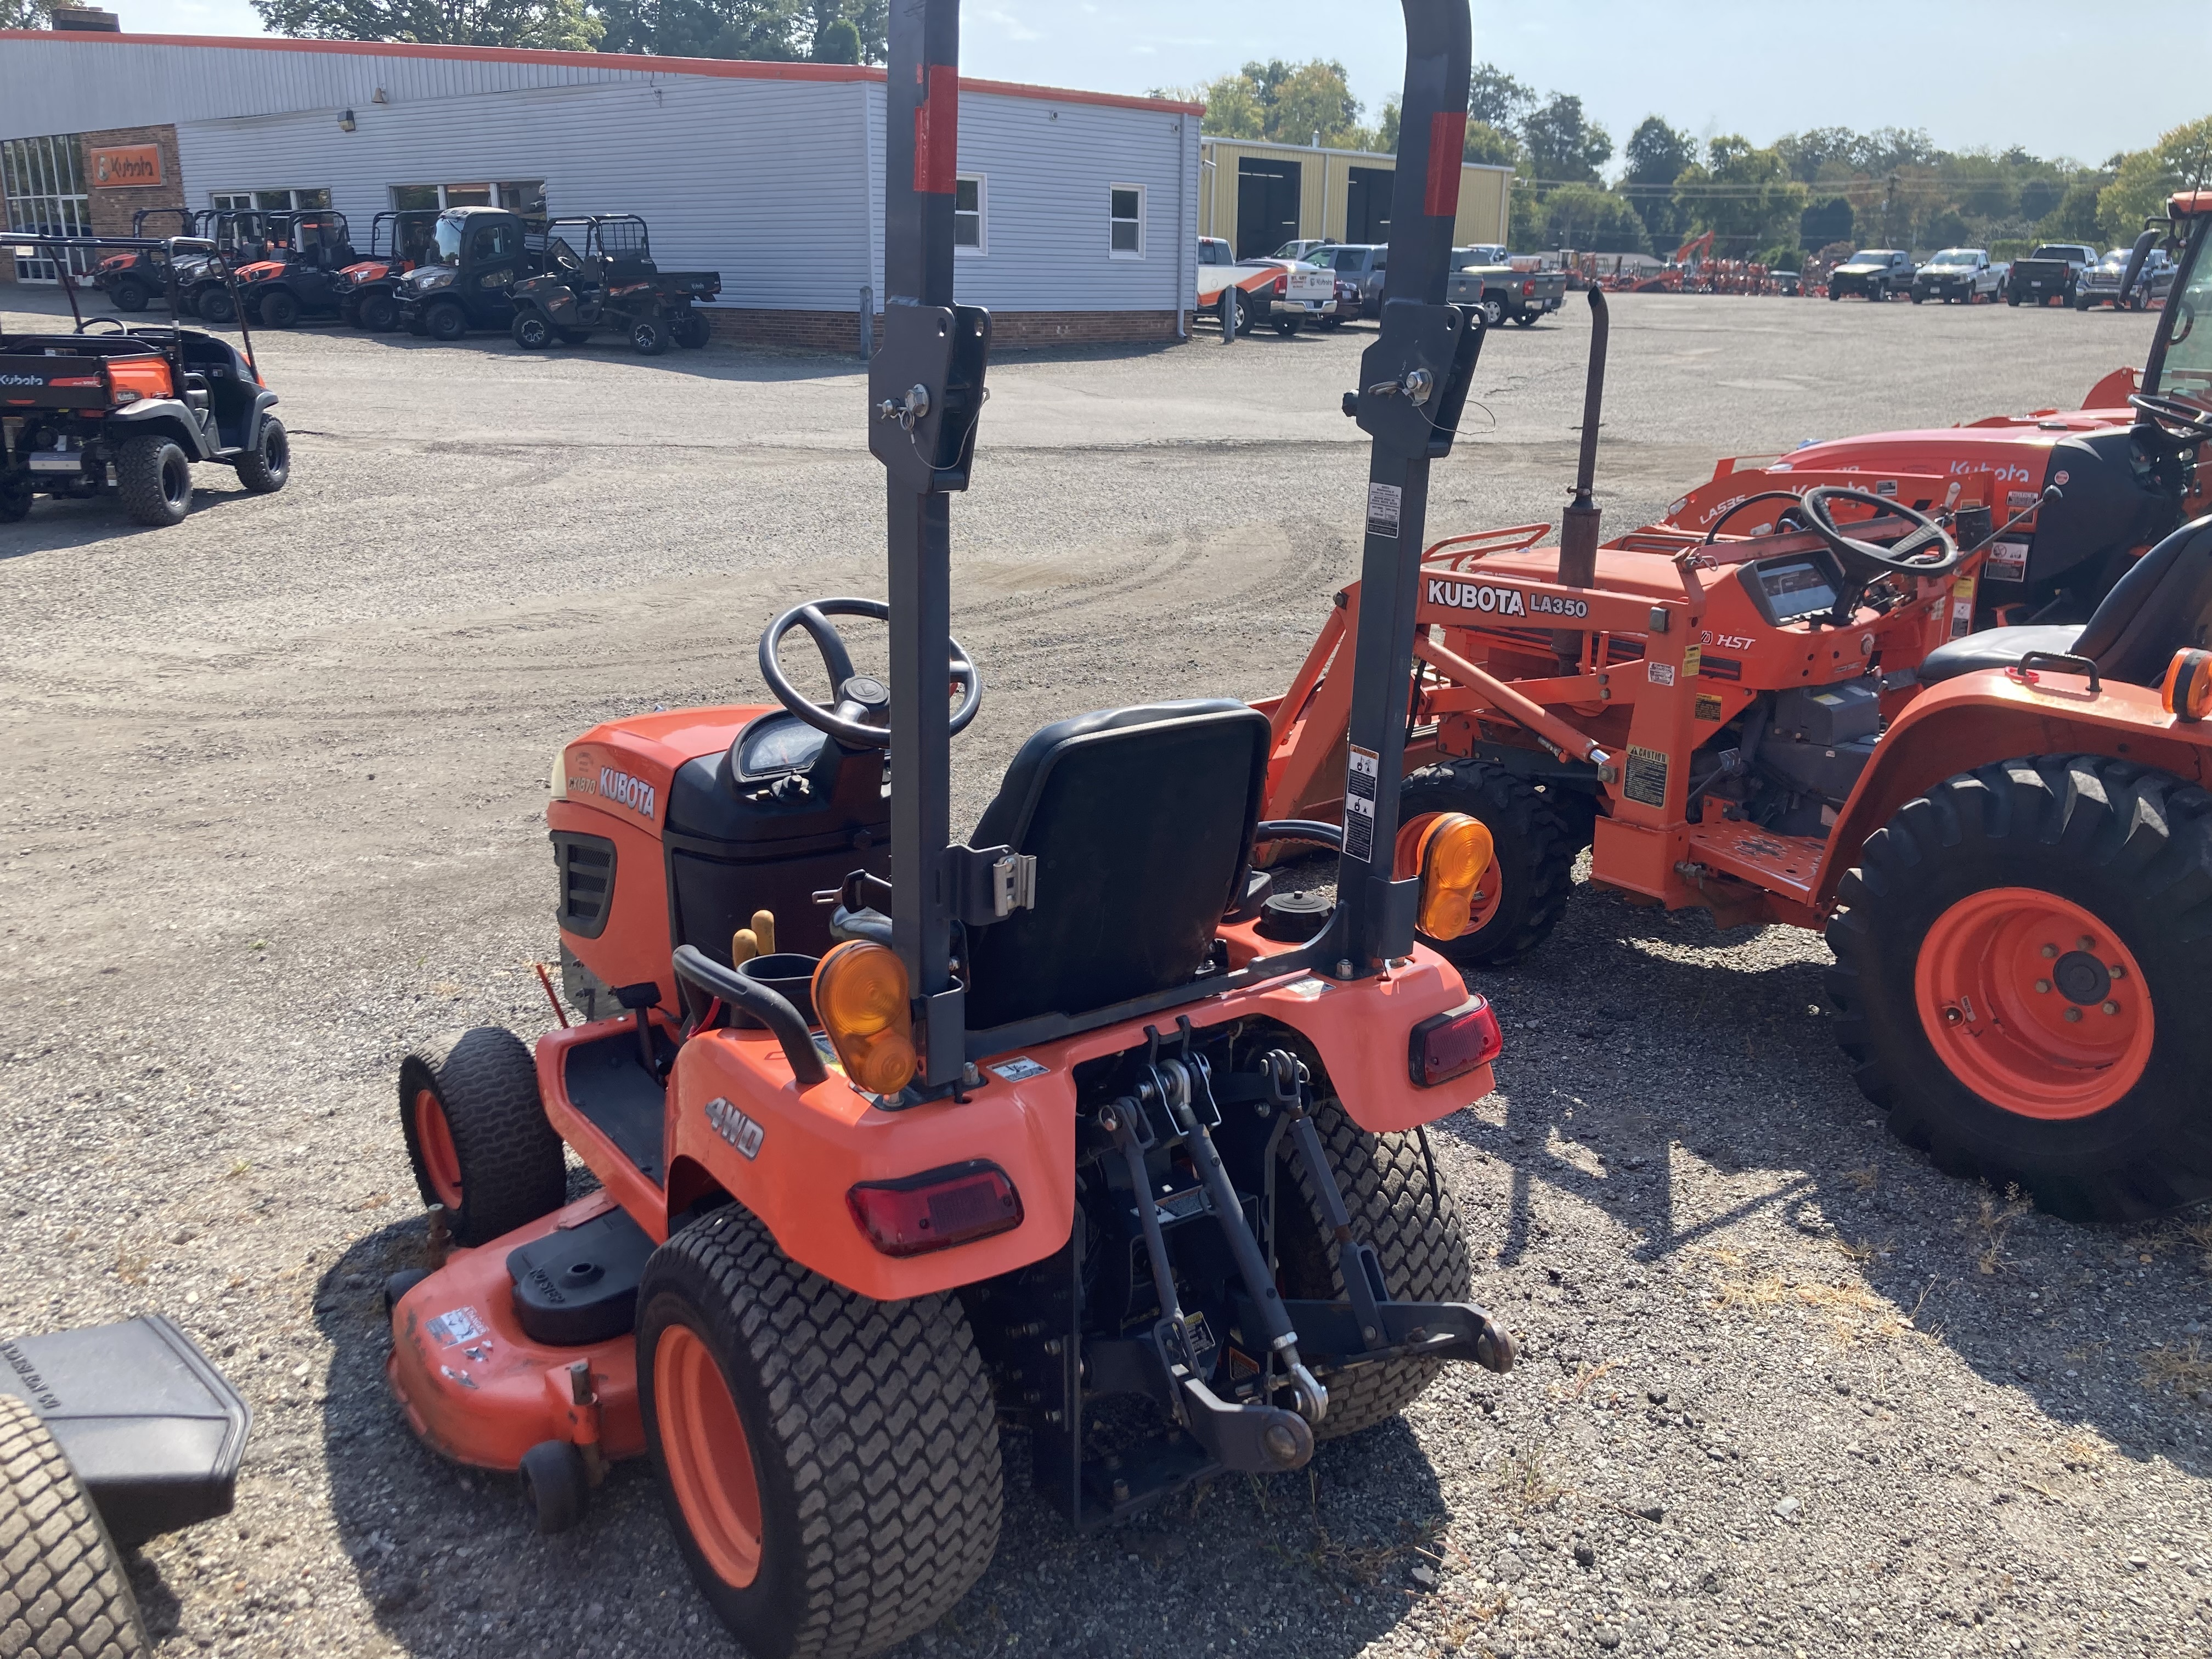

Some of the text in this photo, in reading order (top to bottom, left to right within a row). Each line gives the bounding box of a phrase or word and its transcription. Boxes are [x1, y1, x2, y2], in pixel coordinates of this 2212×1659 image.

[111, 155, 154, 178] Kubota
[0, 374, 43, 385] Kubota
[1700, 494, 1746, 524] LA535
[1428, 579, 1526, 617] KUBOTA
[1530, 594, 1587, 618] LA350
[1717, 634, 1756, 650] HST
[1639, 748, 1666, 762] CAUTION
[600, 767, 655, 820] KUBOTA
[705, 1097, 764, 1160] 4WD
[466, 1310, 488, 1334] DANGER
